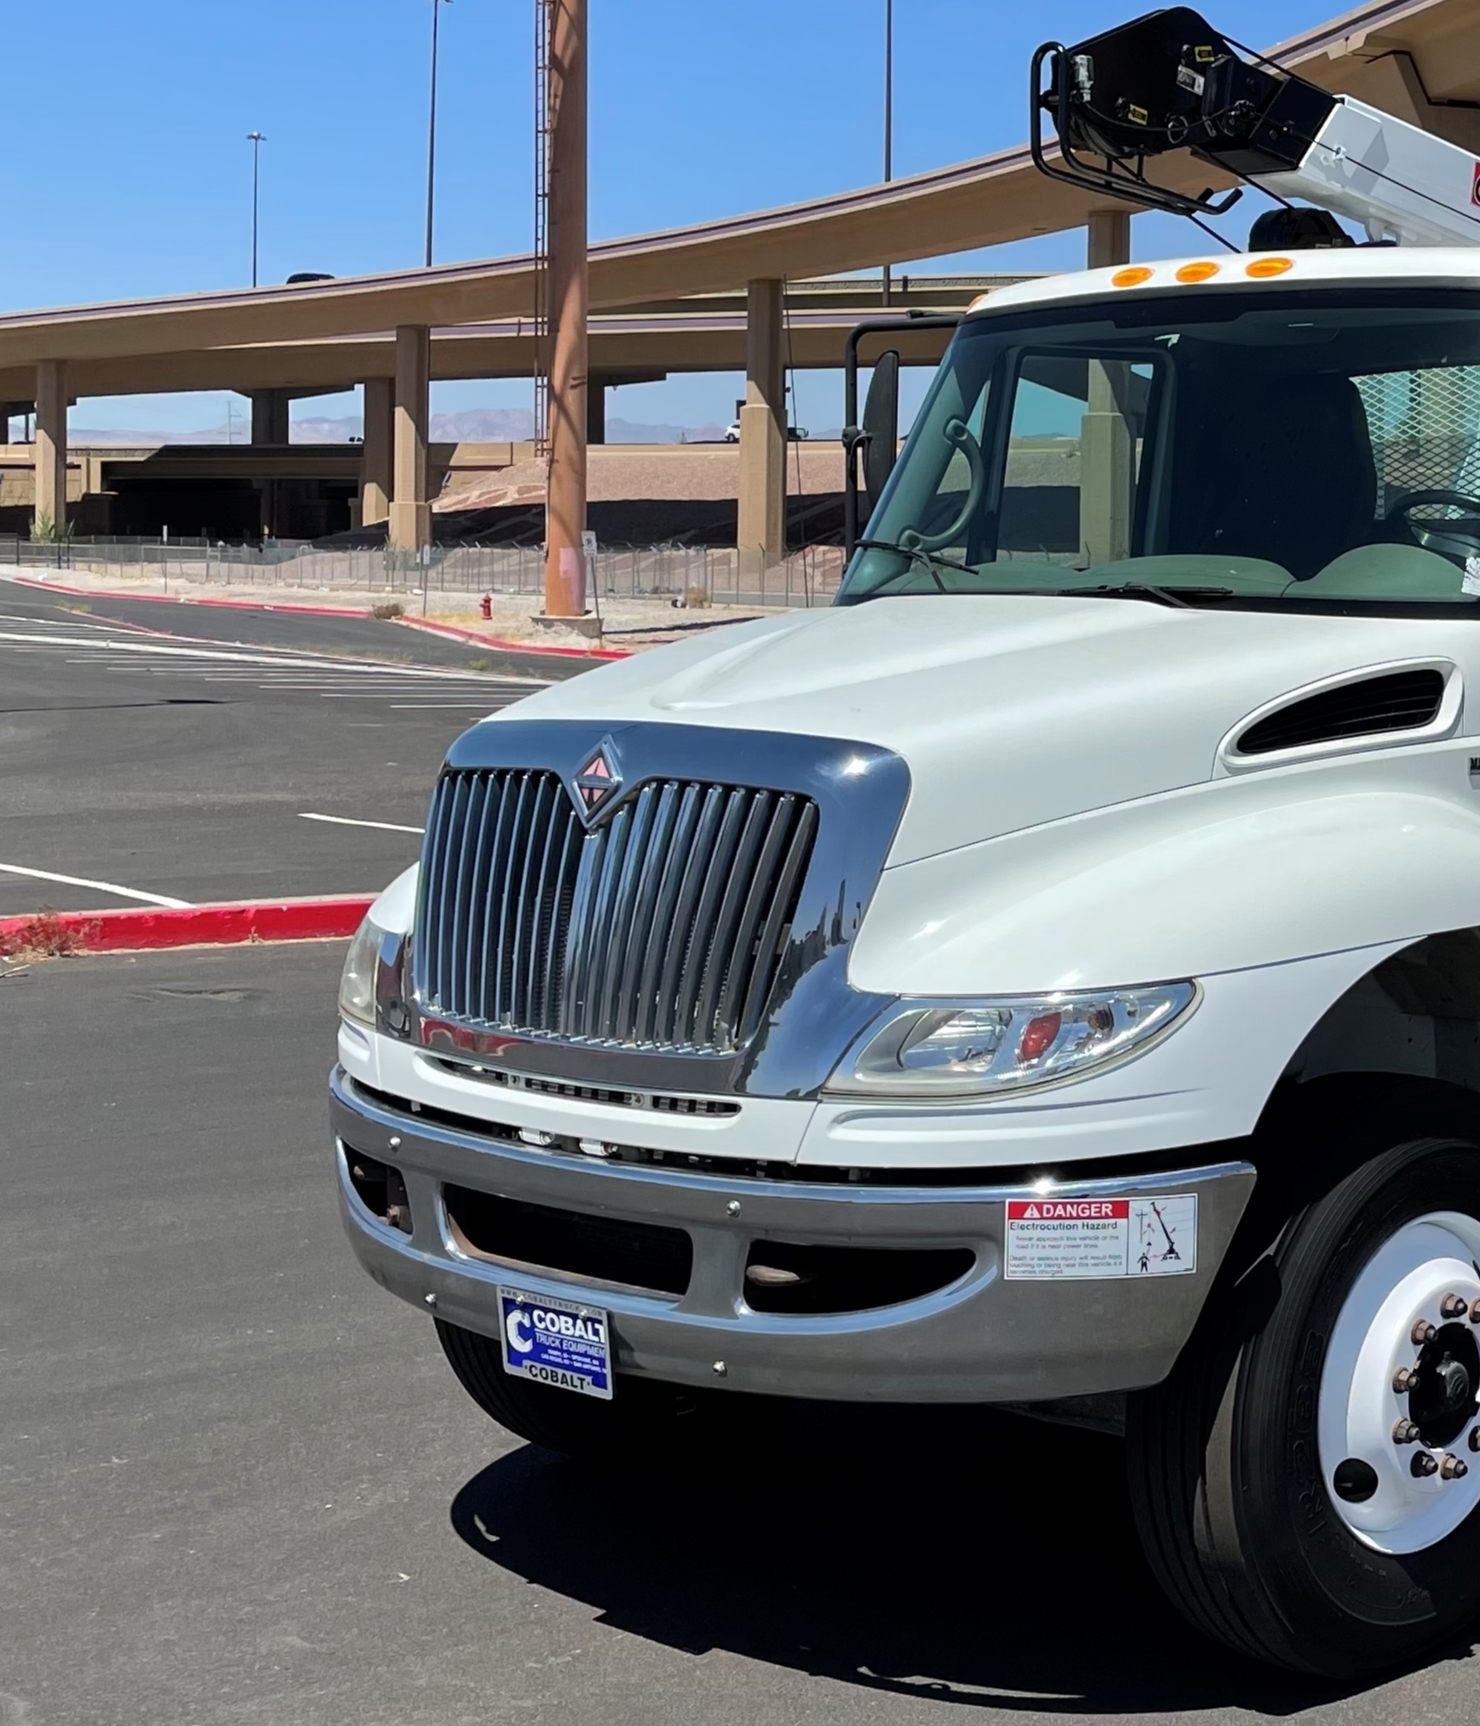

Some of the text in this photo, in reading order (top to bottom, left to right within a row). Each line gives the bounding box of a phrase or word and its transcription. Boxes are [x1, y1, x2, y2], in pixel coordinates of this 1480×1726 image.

[1042, 1203, 1113, 1218] DANGER
[1009, 1220, 1118, 1231] Electrocution Hazard
[533, 1309, 605, 1343] COBALT
[534, 1332, 606, 1359] TRUCK EQUIPMEN
[528, 1364, 586, 1390] COBALT
